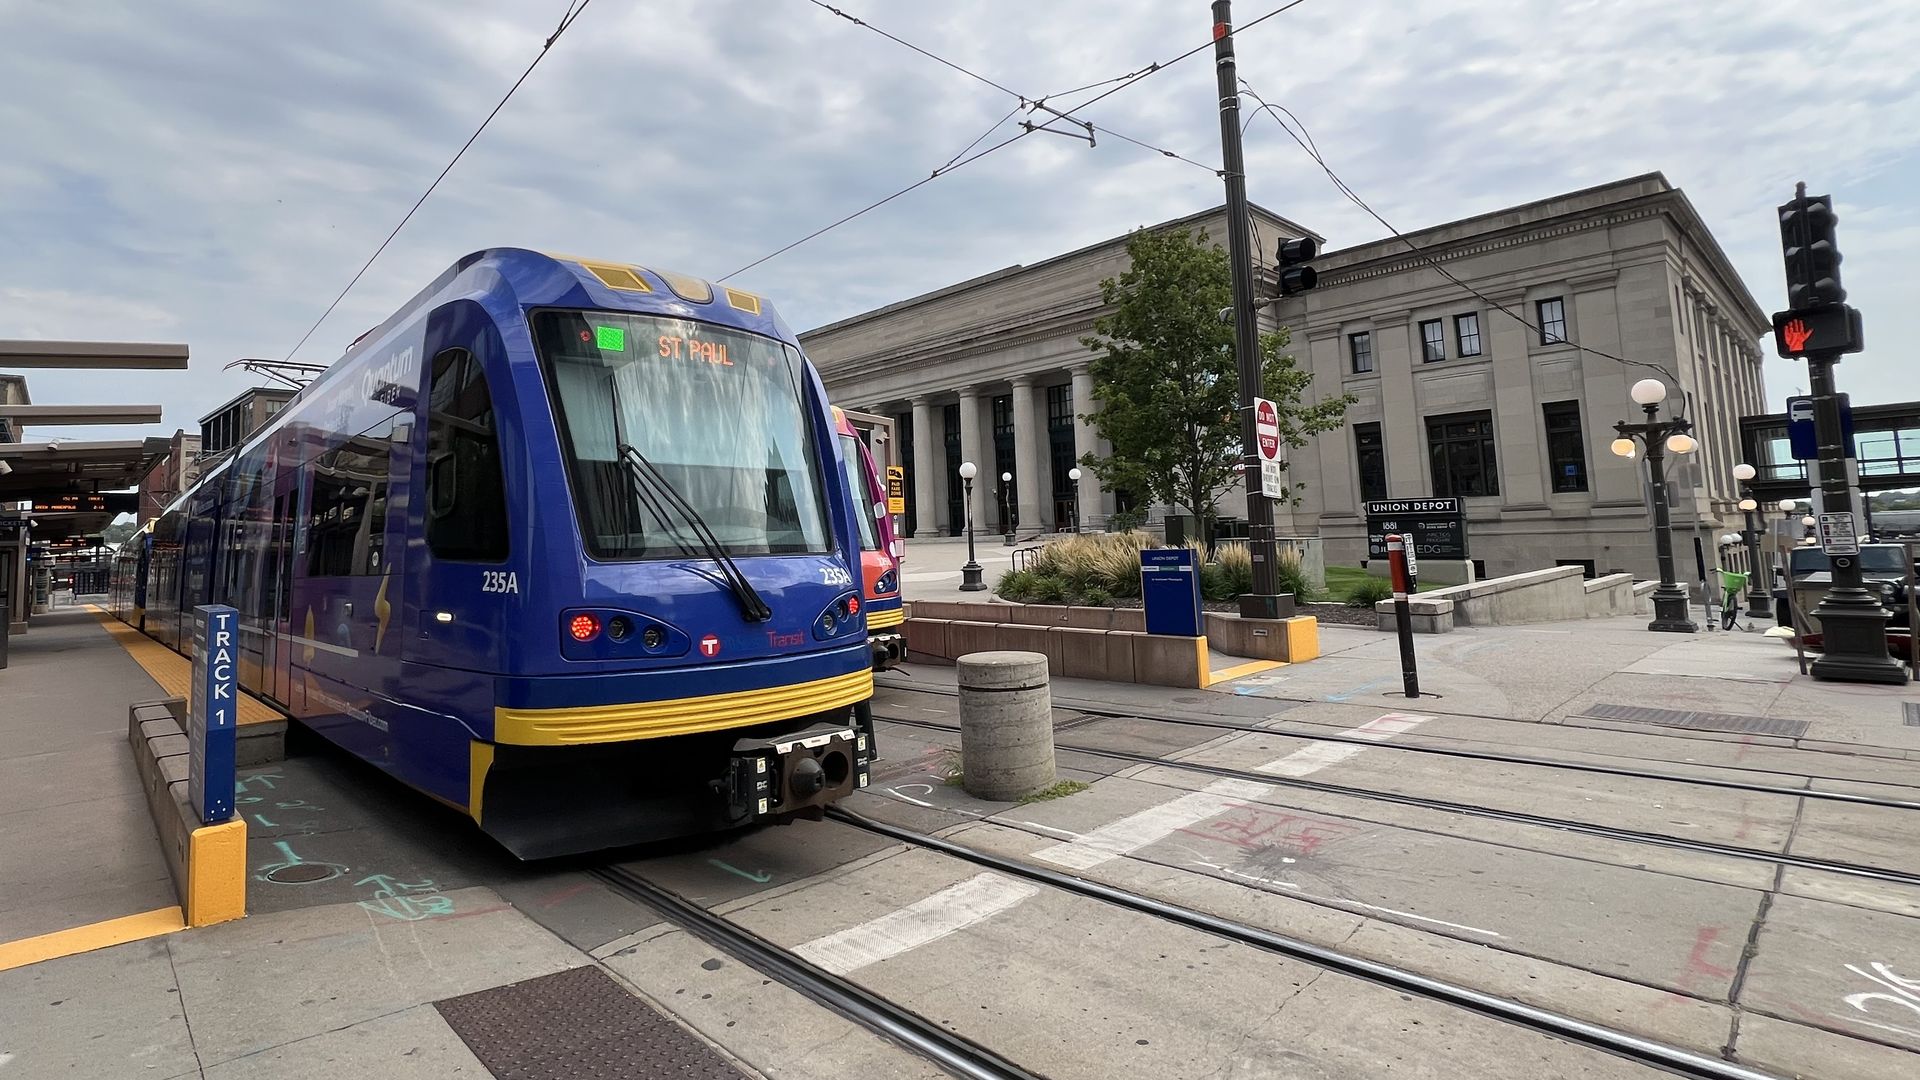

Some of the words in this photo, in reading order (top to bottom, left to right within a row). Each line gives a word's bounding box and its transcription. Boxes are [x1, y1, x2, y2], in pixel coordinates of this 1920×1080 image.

[659, 335, 682, 359] ST
[689, 340, 734, 366] PAUL
[1258, 411, 1265, 421] DO
[1266, 412, 1275, 423] NOT
[1262, 437, 1275, 448] ENTER
[1372, 503, 1409, 512] UNION
[1414, 501, 1451, 511] DEPOT
[1382, 521, 1398, 530] 1881
[1416, 544, 1441, 554] EDG
[482, 570, 519, 594] 235A
[818, 567, 852, 585] 235A
[766, 629, 805, 649] Transit
[213, 613, 231, 700] TRACK
[215, 709, 225, 726] 1
